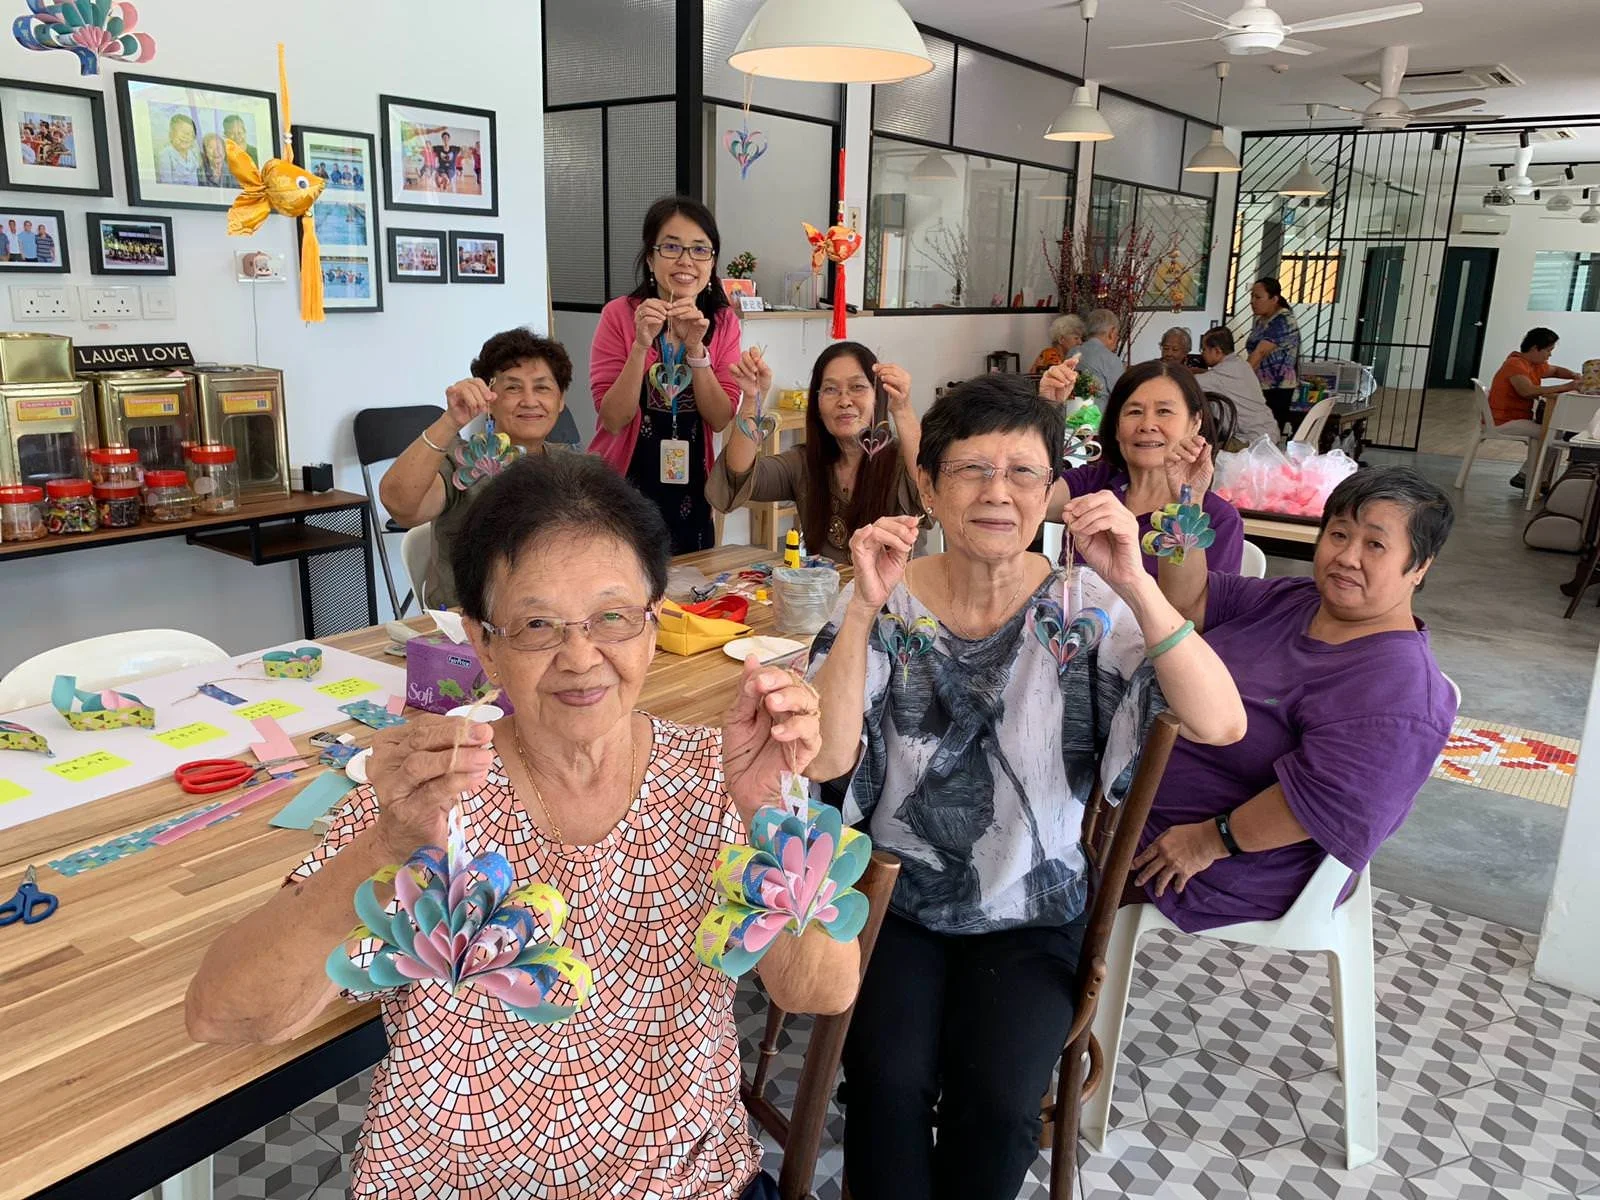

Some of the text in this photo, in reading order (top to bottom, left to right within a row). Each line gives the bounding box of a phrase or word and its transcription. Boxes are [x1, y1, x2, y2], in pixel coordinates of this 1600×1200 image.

[79, 346, 190, 364] LAUGH LOVE
[408, 682, 434, 706] Soft
